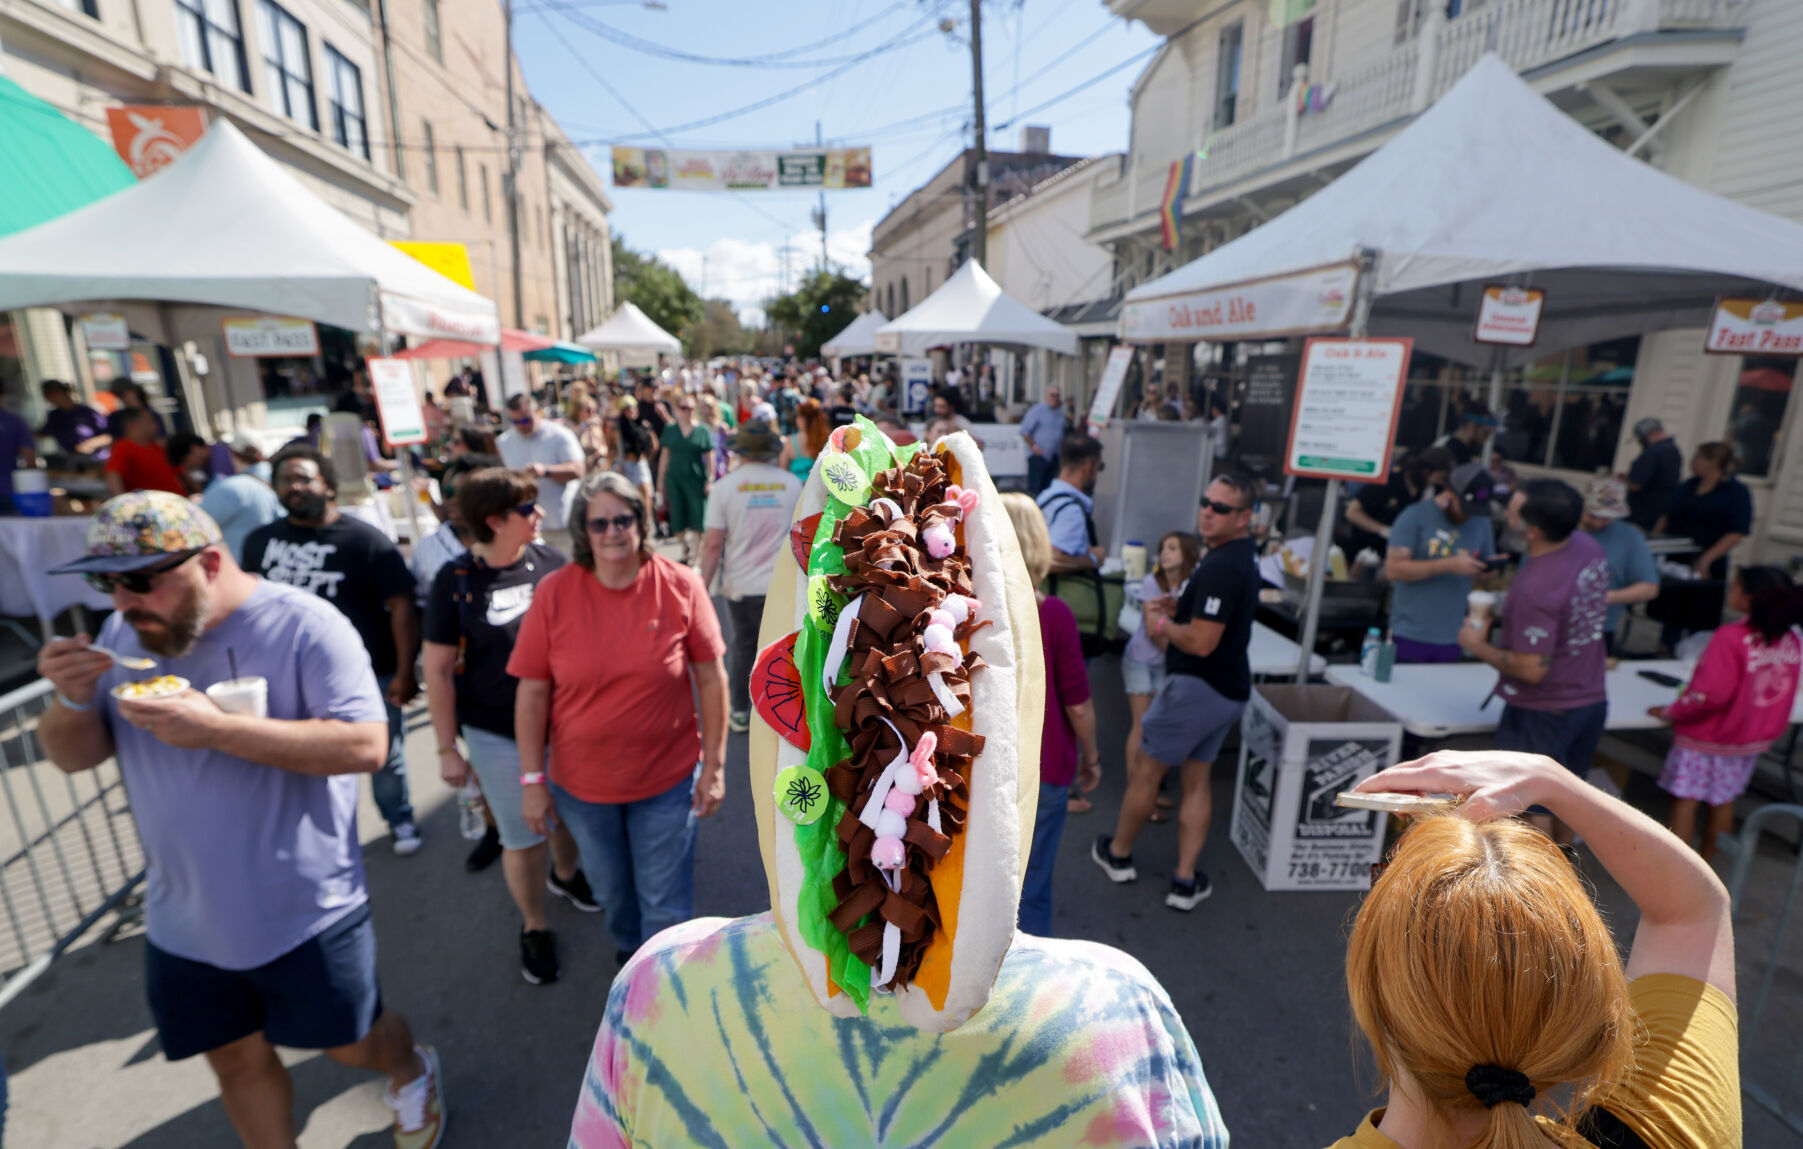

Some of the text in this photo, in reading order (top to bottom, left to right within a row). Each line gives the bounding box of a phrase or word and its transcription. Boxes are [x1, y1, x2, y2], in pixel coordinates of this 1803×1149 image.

[1168, 305, 1192, 329] Oak
[1228, 296, 1257, 324] Ale
[1717, 328, 1803, 349] Fast Pass
[1325, 348, 1350, 359] Oak
[1366, 348, 1387, 359] Ale
[261, 538, 338, 571] MOST
[491, 582, 534, 611] NIKE
[1308, 741, 1362, 775] RIVER
[1297, 823, 1373, 837] DISPOSAL
[1288, 862, 1372, 878] 738-7700
